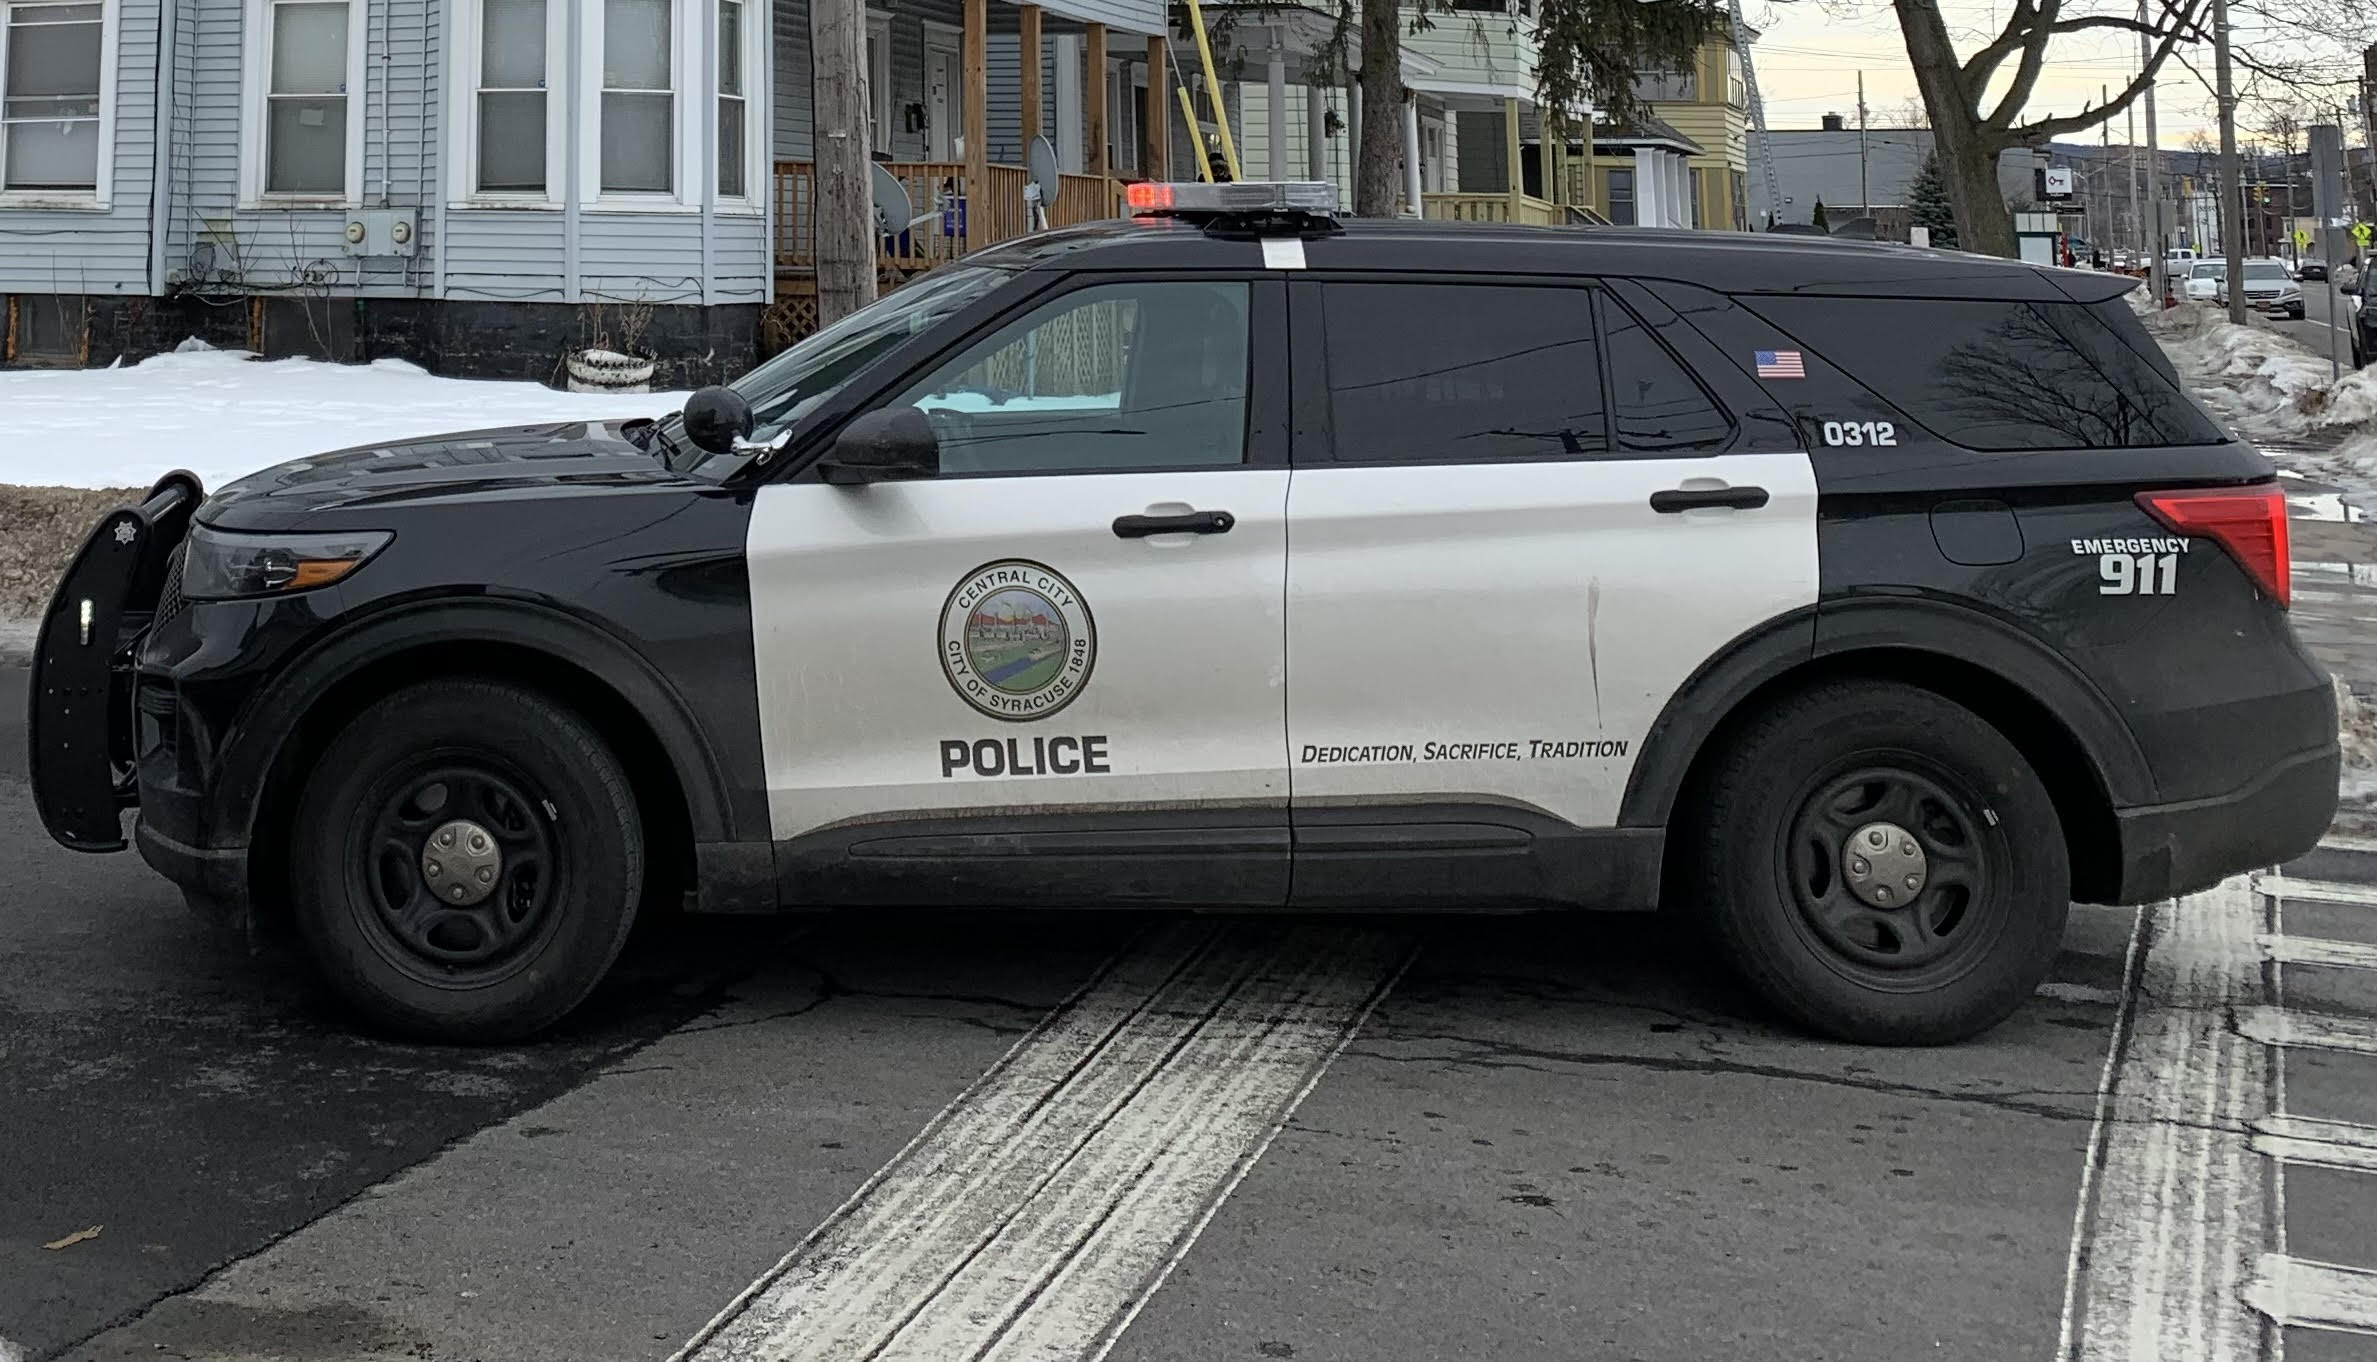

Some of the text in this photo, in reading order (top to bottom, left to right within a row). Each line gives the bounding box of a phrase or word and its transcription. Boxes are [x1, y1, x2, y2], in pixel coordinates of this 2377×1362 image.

[1823, 421, 1897, 446] 0312
[2071, 538, 2190, 554] EMERGENCY
[959, 570, 1073, 610] CENTRAL CITY
[2099, 553, 2178, 595] 911
[948, 638, 1087, 711] CITY OF SYRACUSE 1848
[940, 735, 1111, 778] POLICE
[1529, 739, 1629, 759] TRADITION
